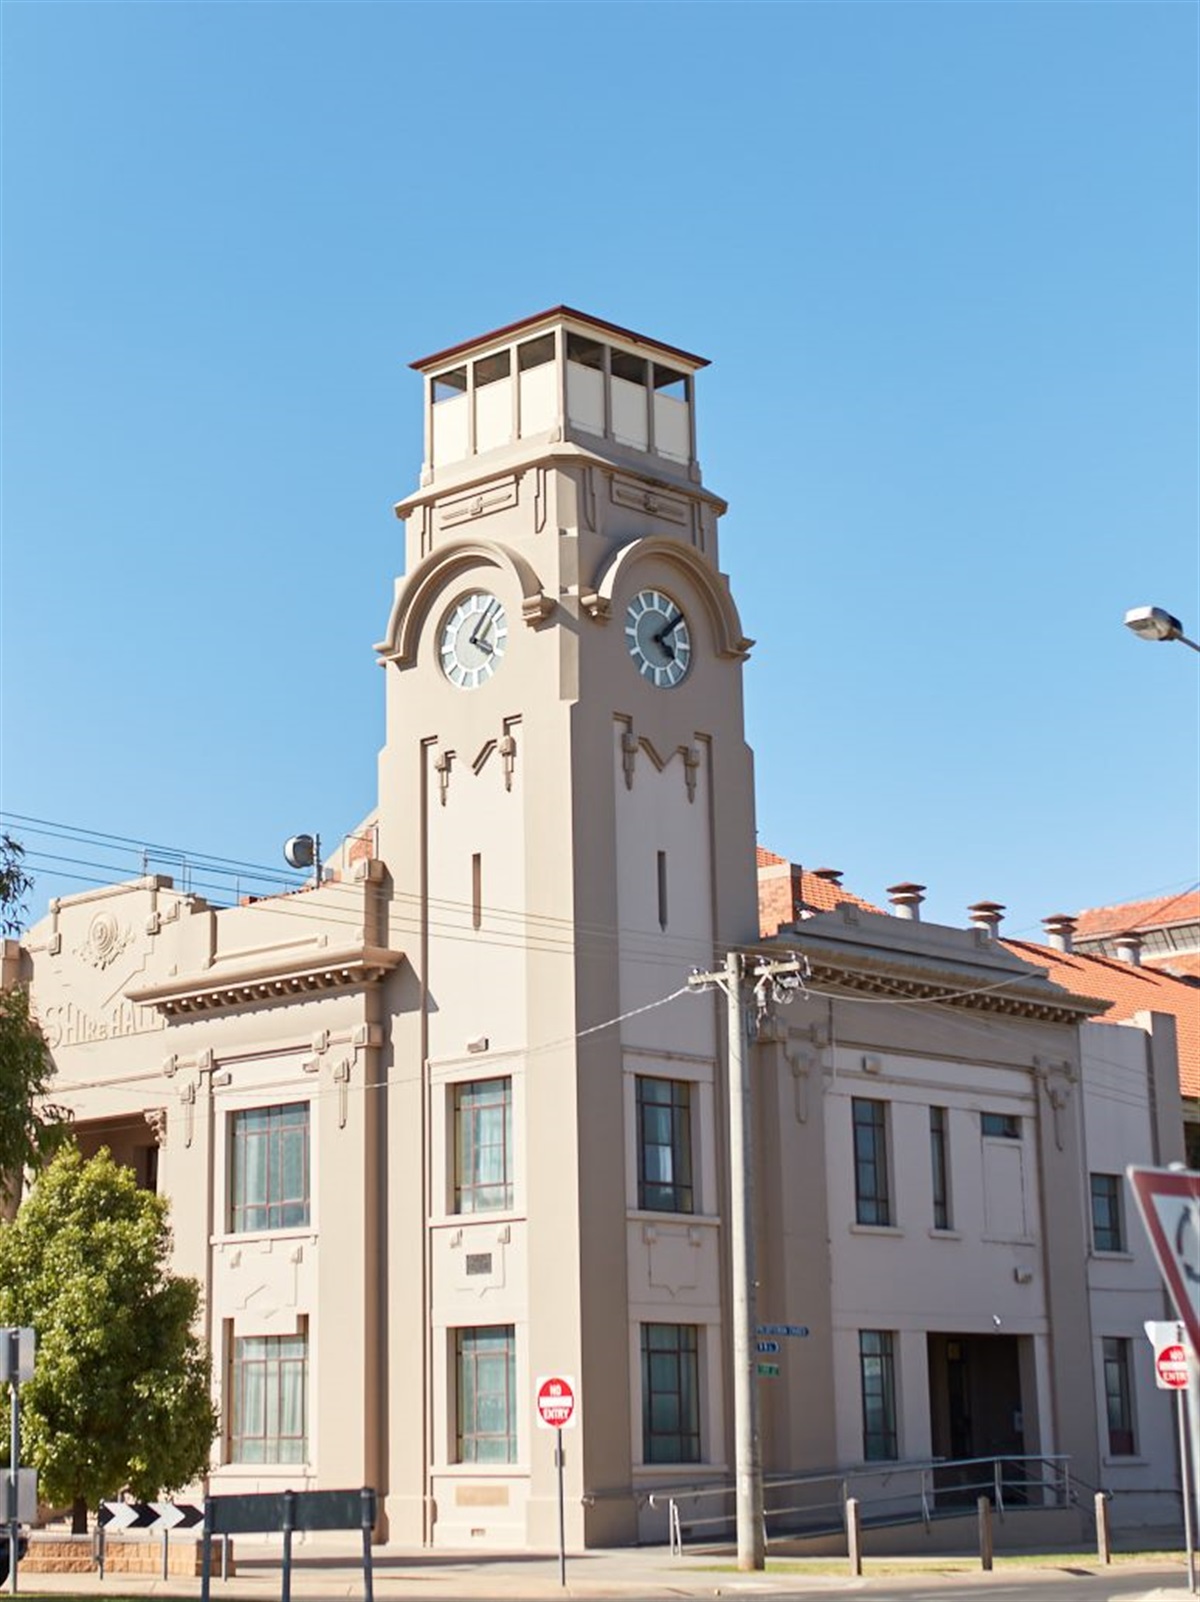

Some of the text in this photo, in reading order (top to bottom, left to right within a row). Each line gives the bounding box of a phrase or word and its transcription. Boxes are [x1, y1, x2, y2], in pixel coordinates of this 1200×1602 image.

[1169, 1350, 1185, 1360] NO
[1163, 1371, 1188, 1381] ENTR
[549, 1384, 562, 1396] NO
[543, 1408, 569, 1420] ENTRY
